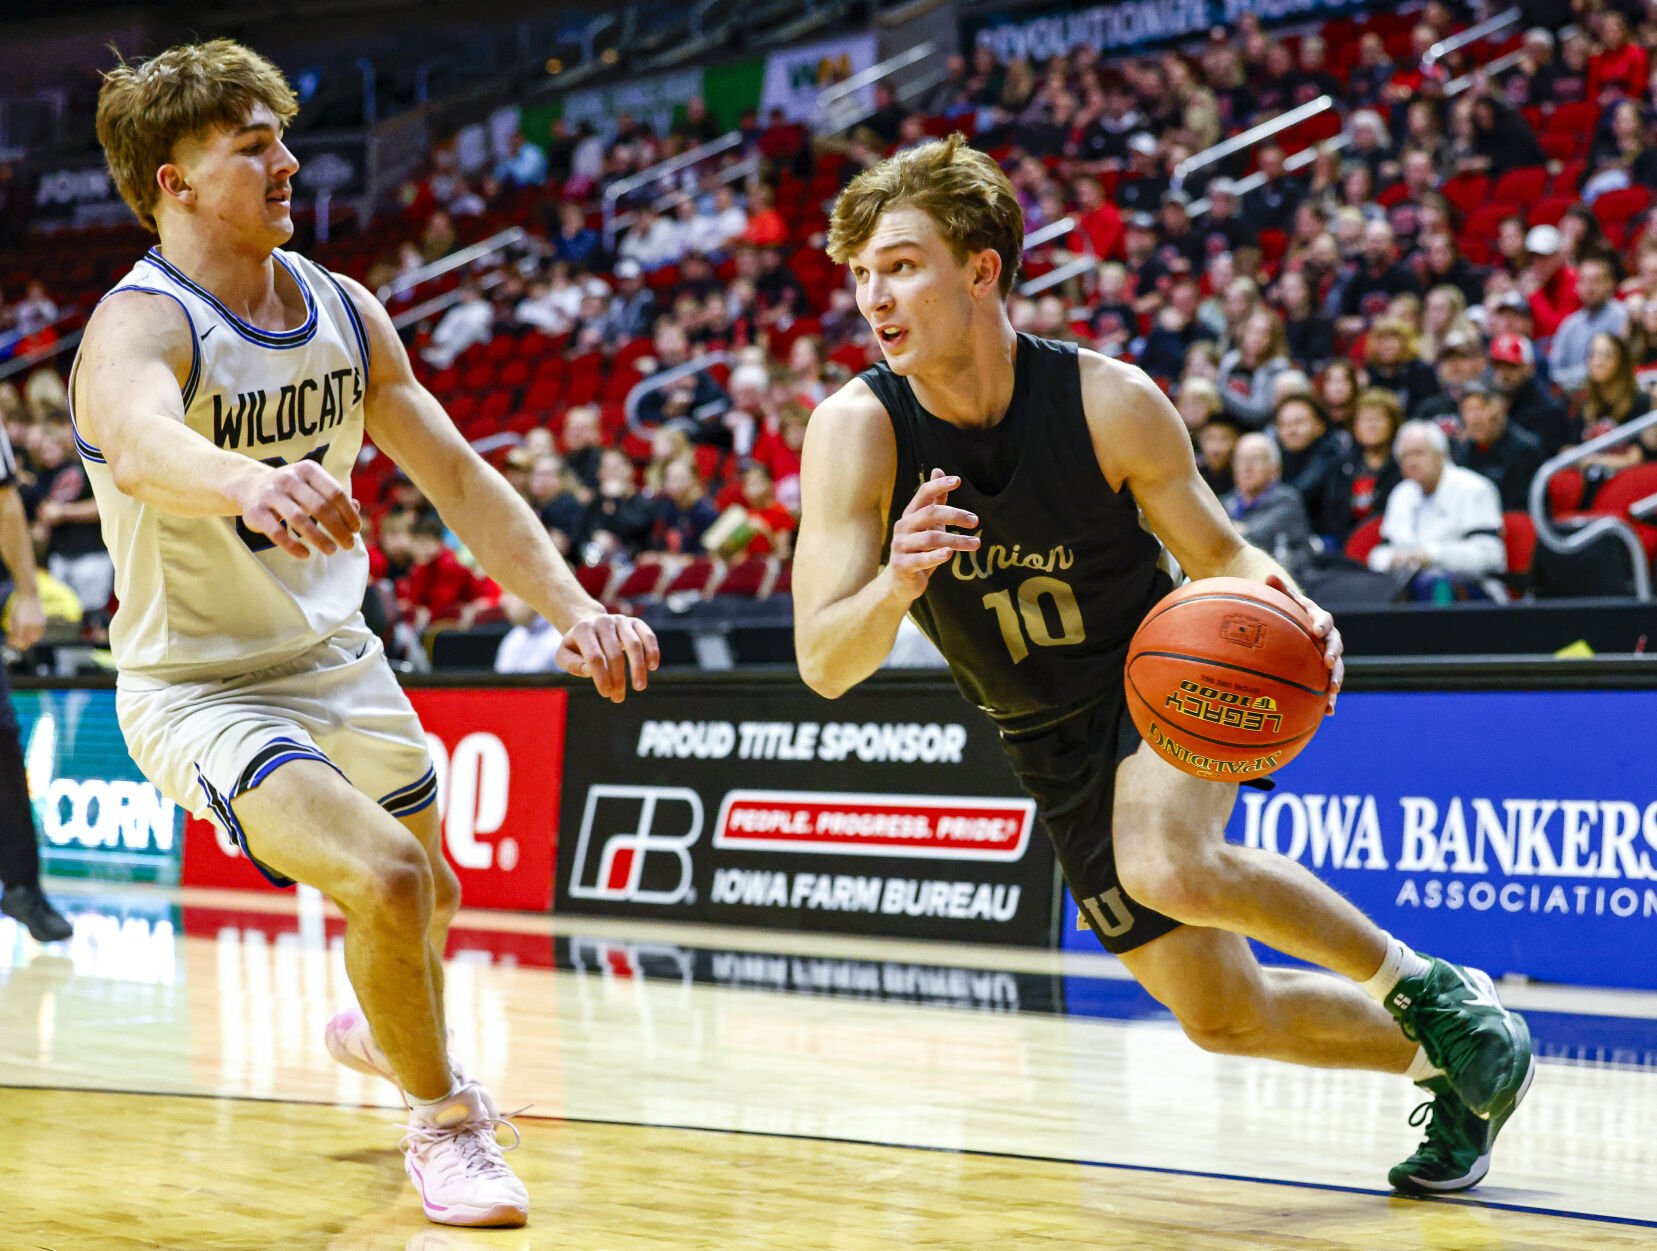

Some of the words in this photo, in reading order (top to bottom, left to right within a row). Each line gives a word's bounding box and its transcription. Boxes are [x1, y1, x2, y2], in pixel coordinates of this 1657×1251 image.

[213, 367, 363, 449] WILDCATS
[951, 529, 1075, 580] Union
[982, 576, 1087, 665] 10
[1165, 690, 1284, 733] LEGACY
[1180, 679, 1251, 707] 1000
[636, 720, 736, 758] PROUD
[738, 721, 820, 760] TITLE
[817, 722, 967, 763] SPONSOR
[1149, 721, 1283, 774] SPALDING
[43, 778, 176, 850] CORN
[729, 807, 813, 835] PEOPLE.
[815, 811, 933, 840] PROGRESS.
[1241, 791, 1390, 870] IOWA
[1395, 795, 1657, 881] BANKERS
[710, 868, 788, 906] IOWA
[790, 872, 882, 914] FARM
[880, 877, 1021, 922] BUREAU
[1082, 886, 1135, 938] U
